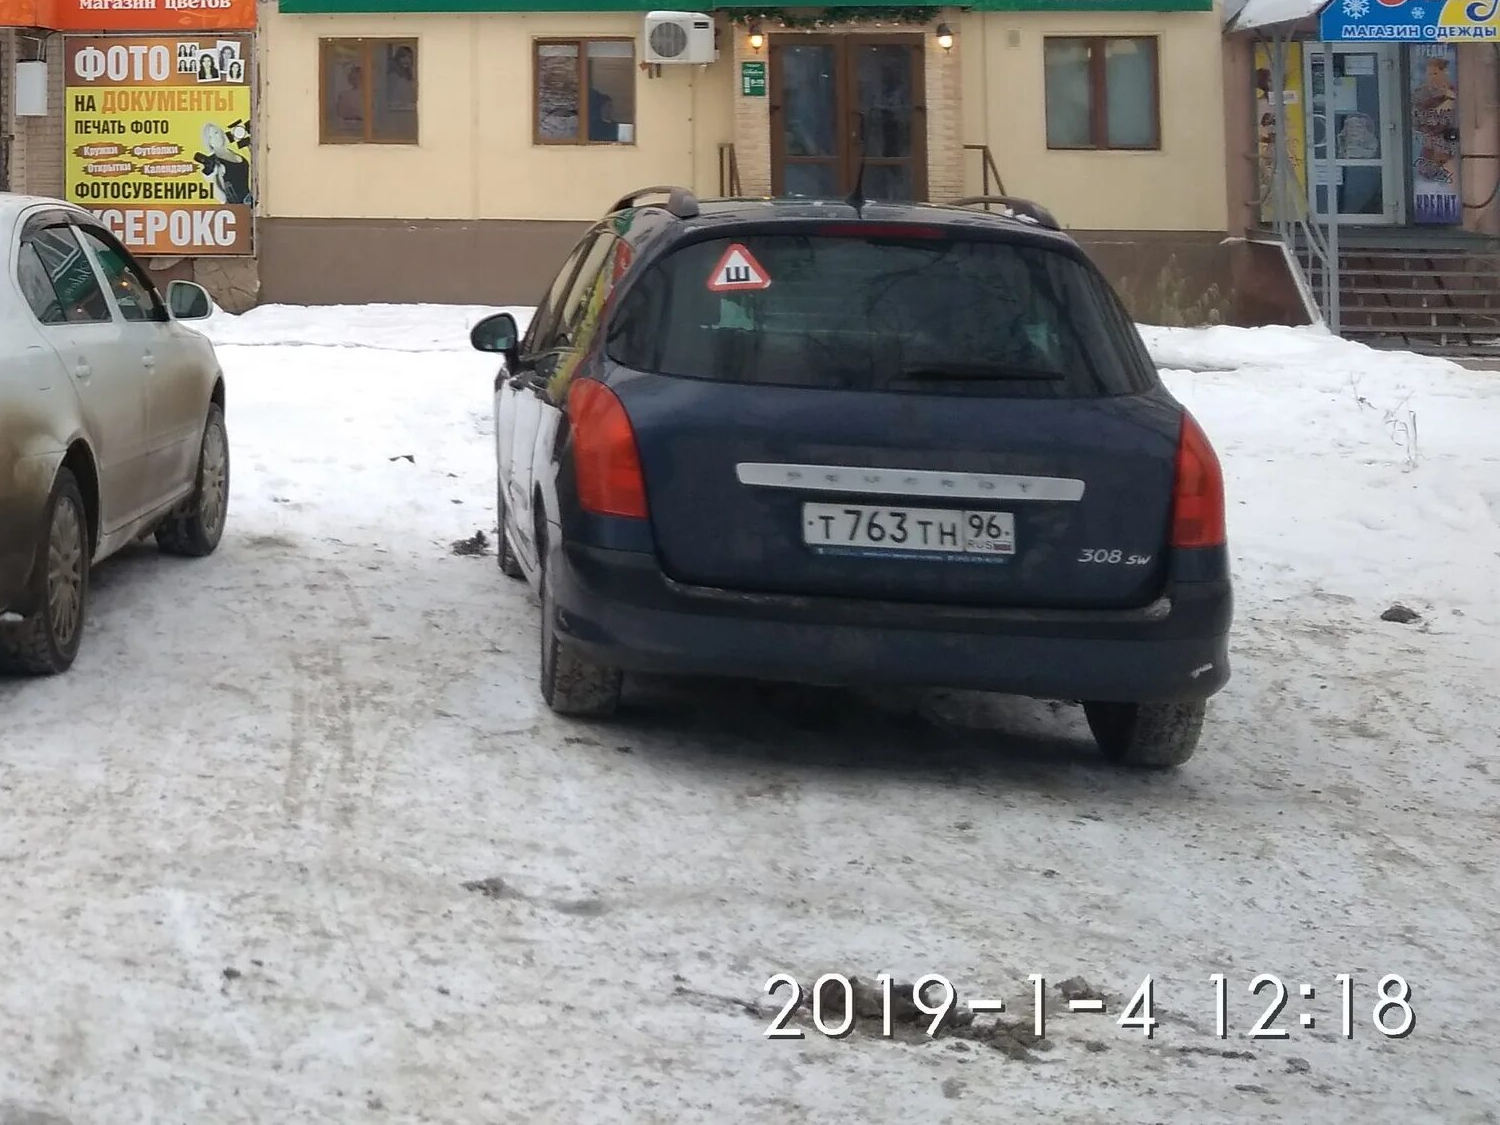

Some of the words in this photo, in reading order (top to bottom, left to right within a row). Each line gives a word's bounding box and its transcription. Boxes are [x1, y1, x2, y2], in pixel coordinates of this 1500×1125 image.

[1342, 25, 1420, 39] МАГАЗИН
[1424, 25, 1498, 40] ОДЕЖДЫ
[74, 45, 170, 82] ФОТО
[75, 95, 97, 113] НА
[101, 90, 235, 114] ДОКУМЕНТЫ
[75, 120, 126, 135] ПЕЧАТЬ
[131, 119, 170, 135] ФОТО
[83, 146, 118, 156] Кружки
[134, 145, 178, 156] Футболки
[88, 163, 132, 173] Открытки
[144, 163, 194, 174] Календари
[75, 182, 214, 199] ФОТОСУВЕНИРЫ
[968, 514, 1002, 540] 96
[1077, 548, 1123, 564] 308
